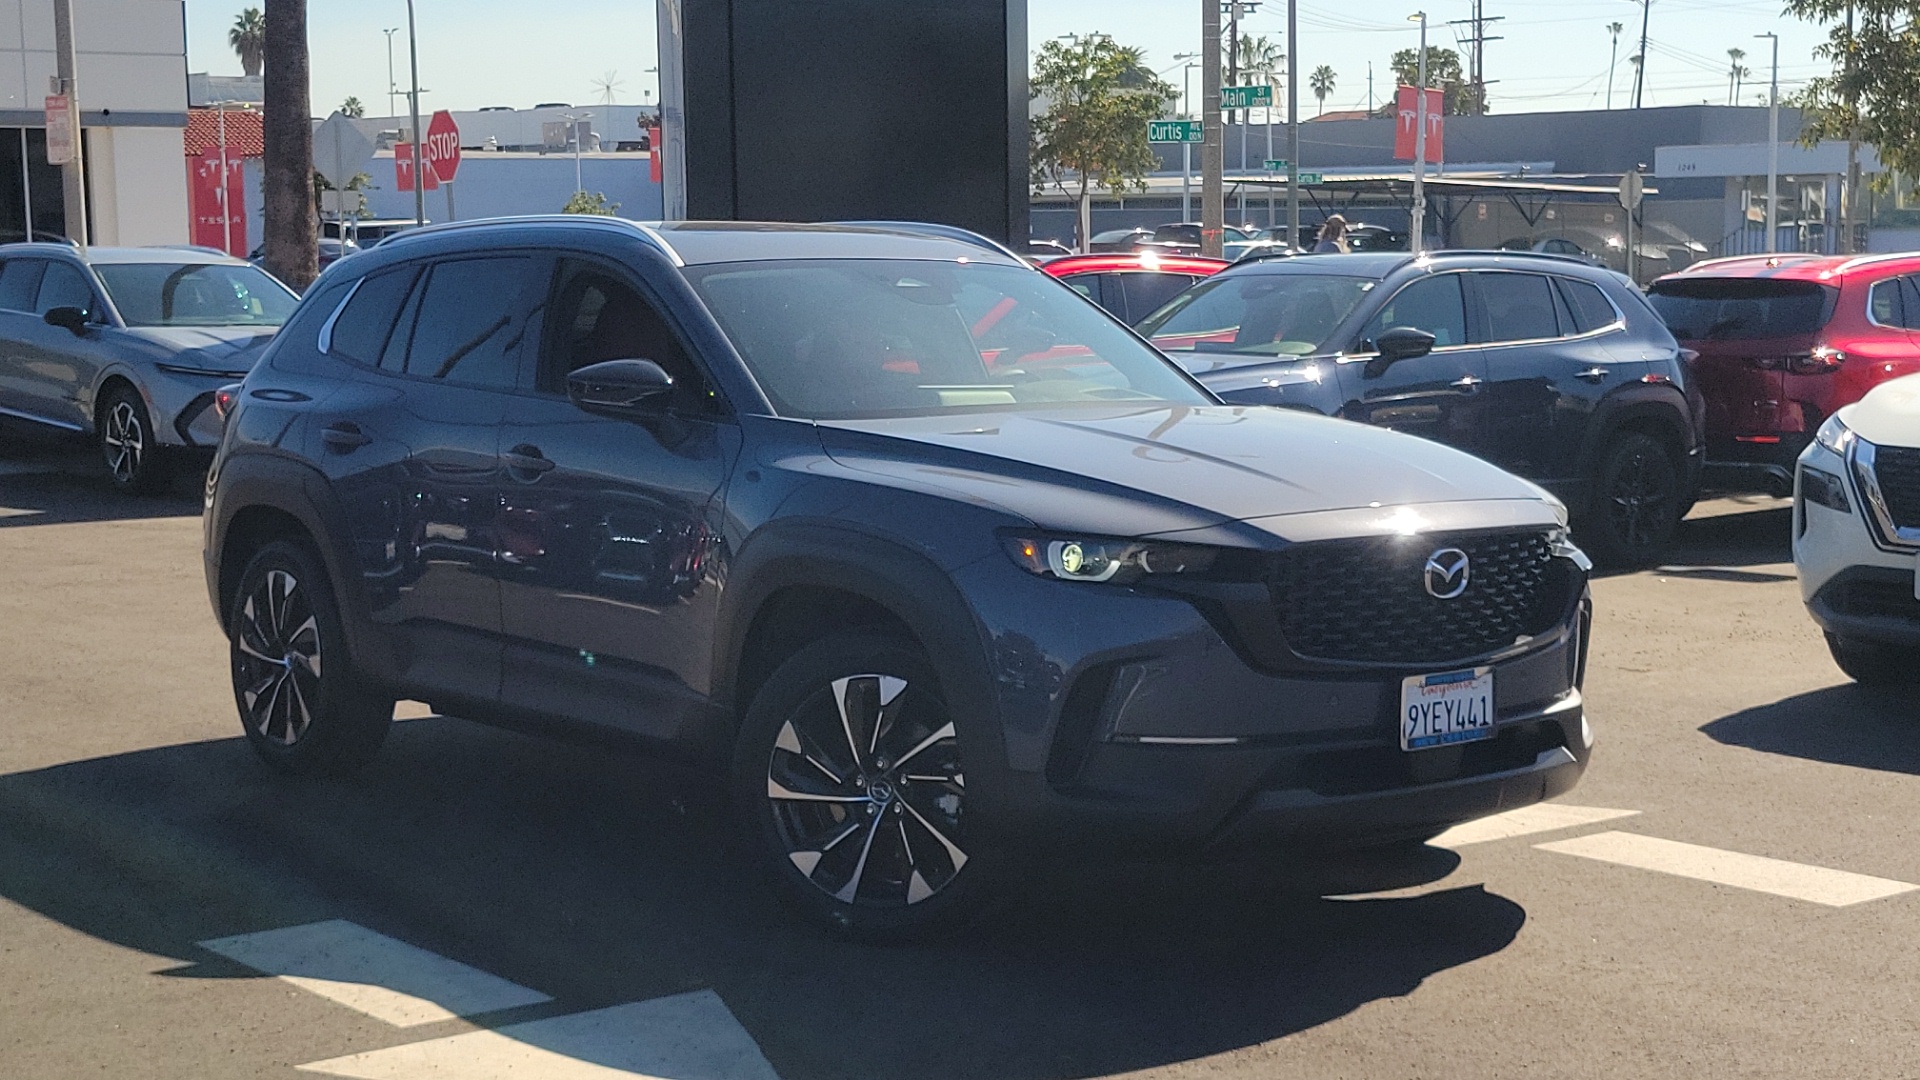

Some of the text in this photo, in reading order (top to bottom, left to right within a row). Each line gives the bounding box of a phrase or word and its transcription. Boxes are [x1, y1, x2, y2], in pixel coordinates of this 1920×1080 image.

[1221, 87, 1265, 106] Main ST
[1149, 122, 1201, 140] Curtis AVE
[429, 131, 458, 161] STOP
[198, 216, 241, 225] TESA
[1408, 696, 1490, 737] 9YEY441
